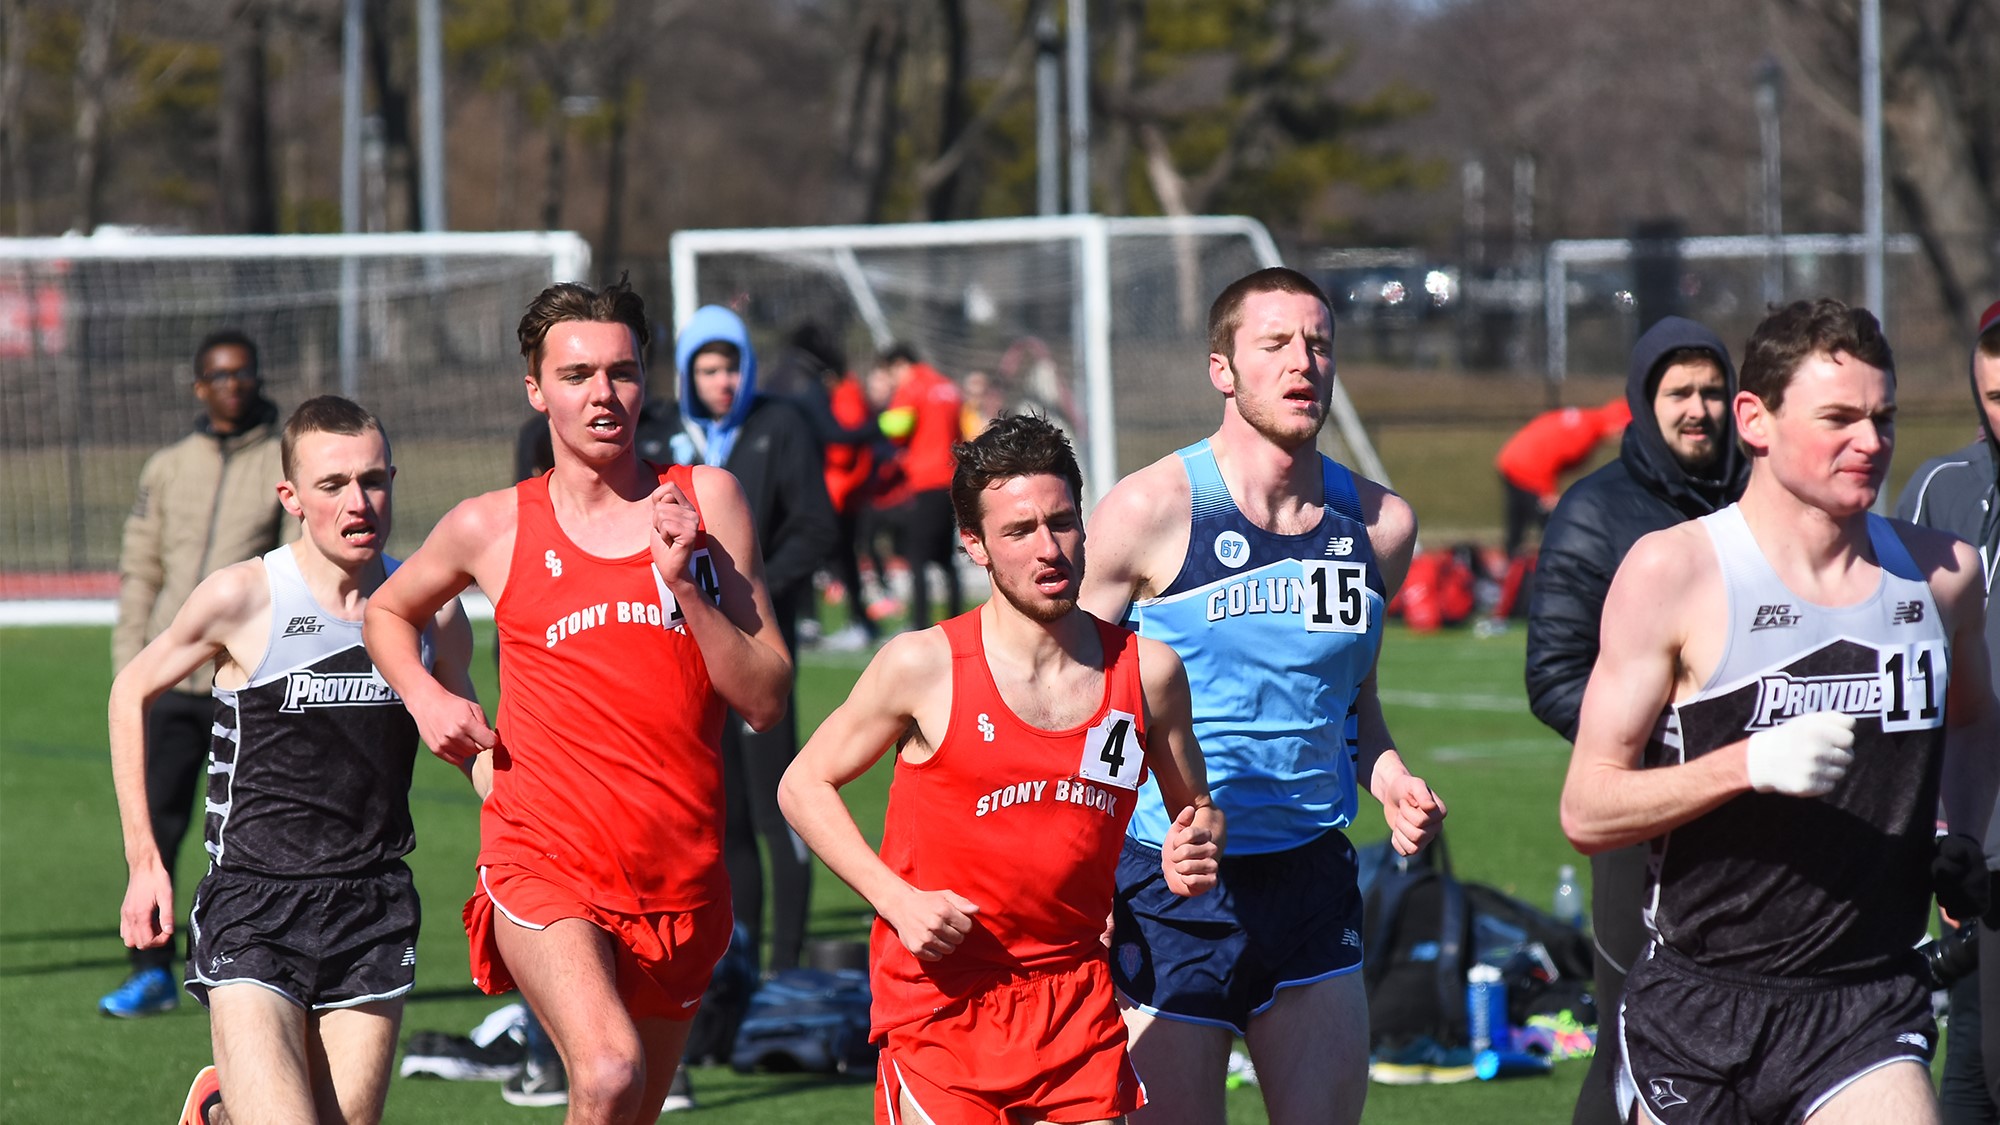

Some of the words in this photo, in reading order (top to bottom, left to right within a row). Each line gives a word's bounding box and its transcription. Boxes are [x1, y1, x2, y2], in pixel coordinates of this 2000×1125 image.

[544, 549, 563, 577] SB
[1220, 539, 1244, 559] 67
[1310, 567, 1362, 626] 15
[1756, 604, 1792, 616] BIG
[284, 625, 325, 634] EAST
[288, 616, 318, 625] BIG
[545, 603, 609, 648] STONY
[616, 601, 687, 636] BRO
[1752, 615, 1802, 627] EAST
[284, 671, 402, 711] PROVID
[1751, 676, 1882, 727] PROVIDE
[1885, 649, 1940, 722] 11
[977, 713, 995, 742] SB
[1099, 718, 1131, 778] 4
[975, 780, 1048, 818] STONY
[1054, 779, 1118, 818] BROOK
